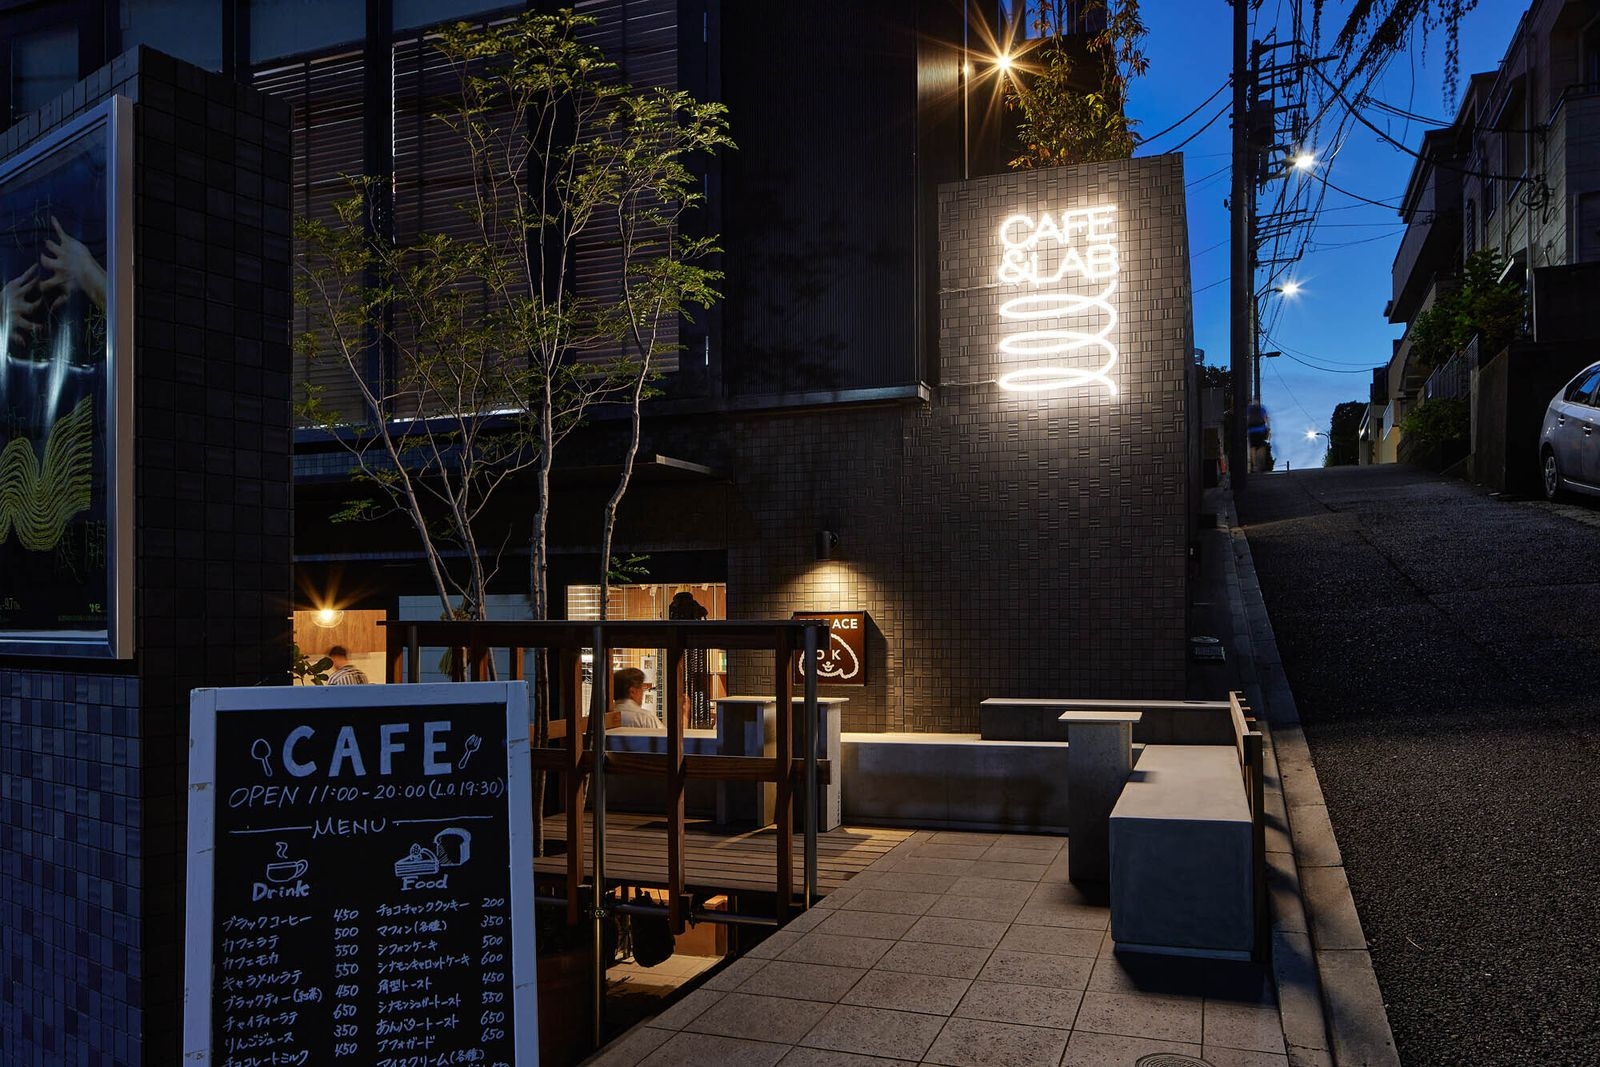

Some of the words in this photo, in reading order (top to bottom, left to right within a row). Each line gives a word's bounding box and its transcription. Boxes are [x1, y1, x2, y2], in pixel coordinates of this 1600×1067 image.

[1000, 204, 1118, 250] CAFE
[999, 244, 1120, 286] &LAB
[282, 721, 452, 777] CAFE
[228, 785, 299, 808] OPEN
[312, 816, 387, 839] MENU
[253, 880, 311, 900] Drink
[400, 874, 448, 891] Food
[481, 898, 504, 908] 200
[222, 915, 312, 932] ブラックコーヒー
[333, 909, 359, 922] 450
[480, 915, 504, 928] 350
[222, 935, 280, 953] カフェラテ
[334, 927, 359, 940] 500
[482, 936, 503, 949] 500
[222, 952, 279, 970] カフェモカ
[335, 945, 359, 958] 550
[480, 952, 503, 965] 600
[223, 970, 303, 991] キャラメルラテ
[334, 962, 359, 978] 550
[482, 972, 504, 985] 450
[335, 984, 359, 998] 450
[482, 992, 504, 1004] 550
[222, 1011, 299, 1032] チャイティーラテ
[333, 1003, 357, 1019] 650
[376, 1013, 460, 1035] あんバタートースト
[480, 1010, 504, 1026] 650
[225, 1032, 294, 1054] りんごジュース
[333, 1024, 358, 1037] 350
[481, 1028, 504, 1042] 650
[334, 1042, 358, 1057] 450
